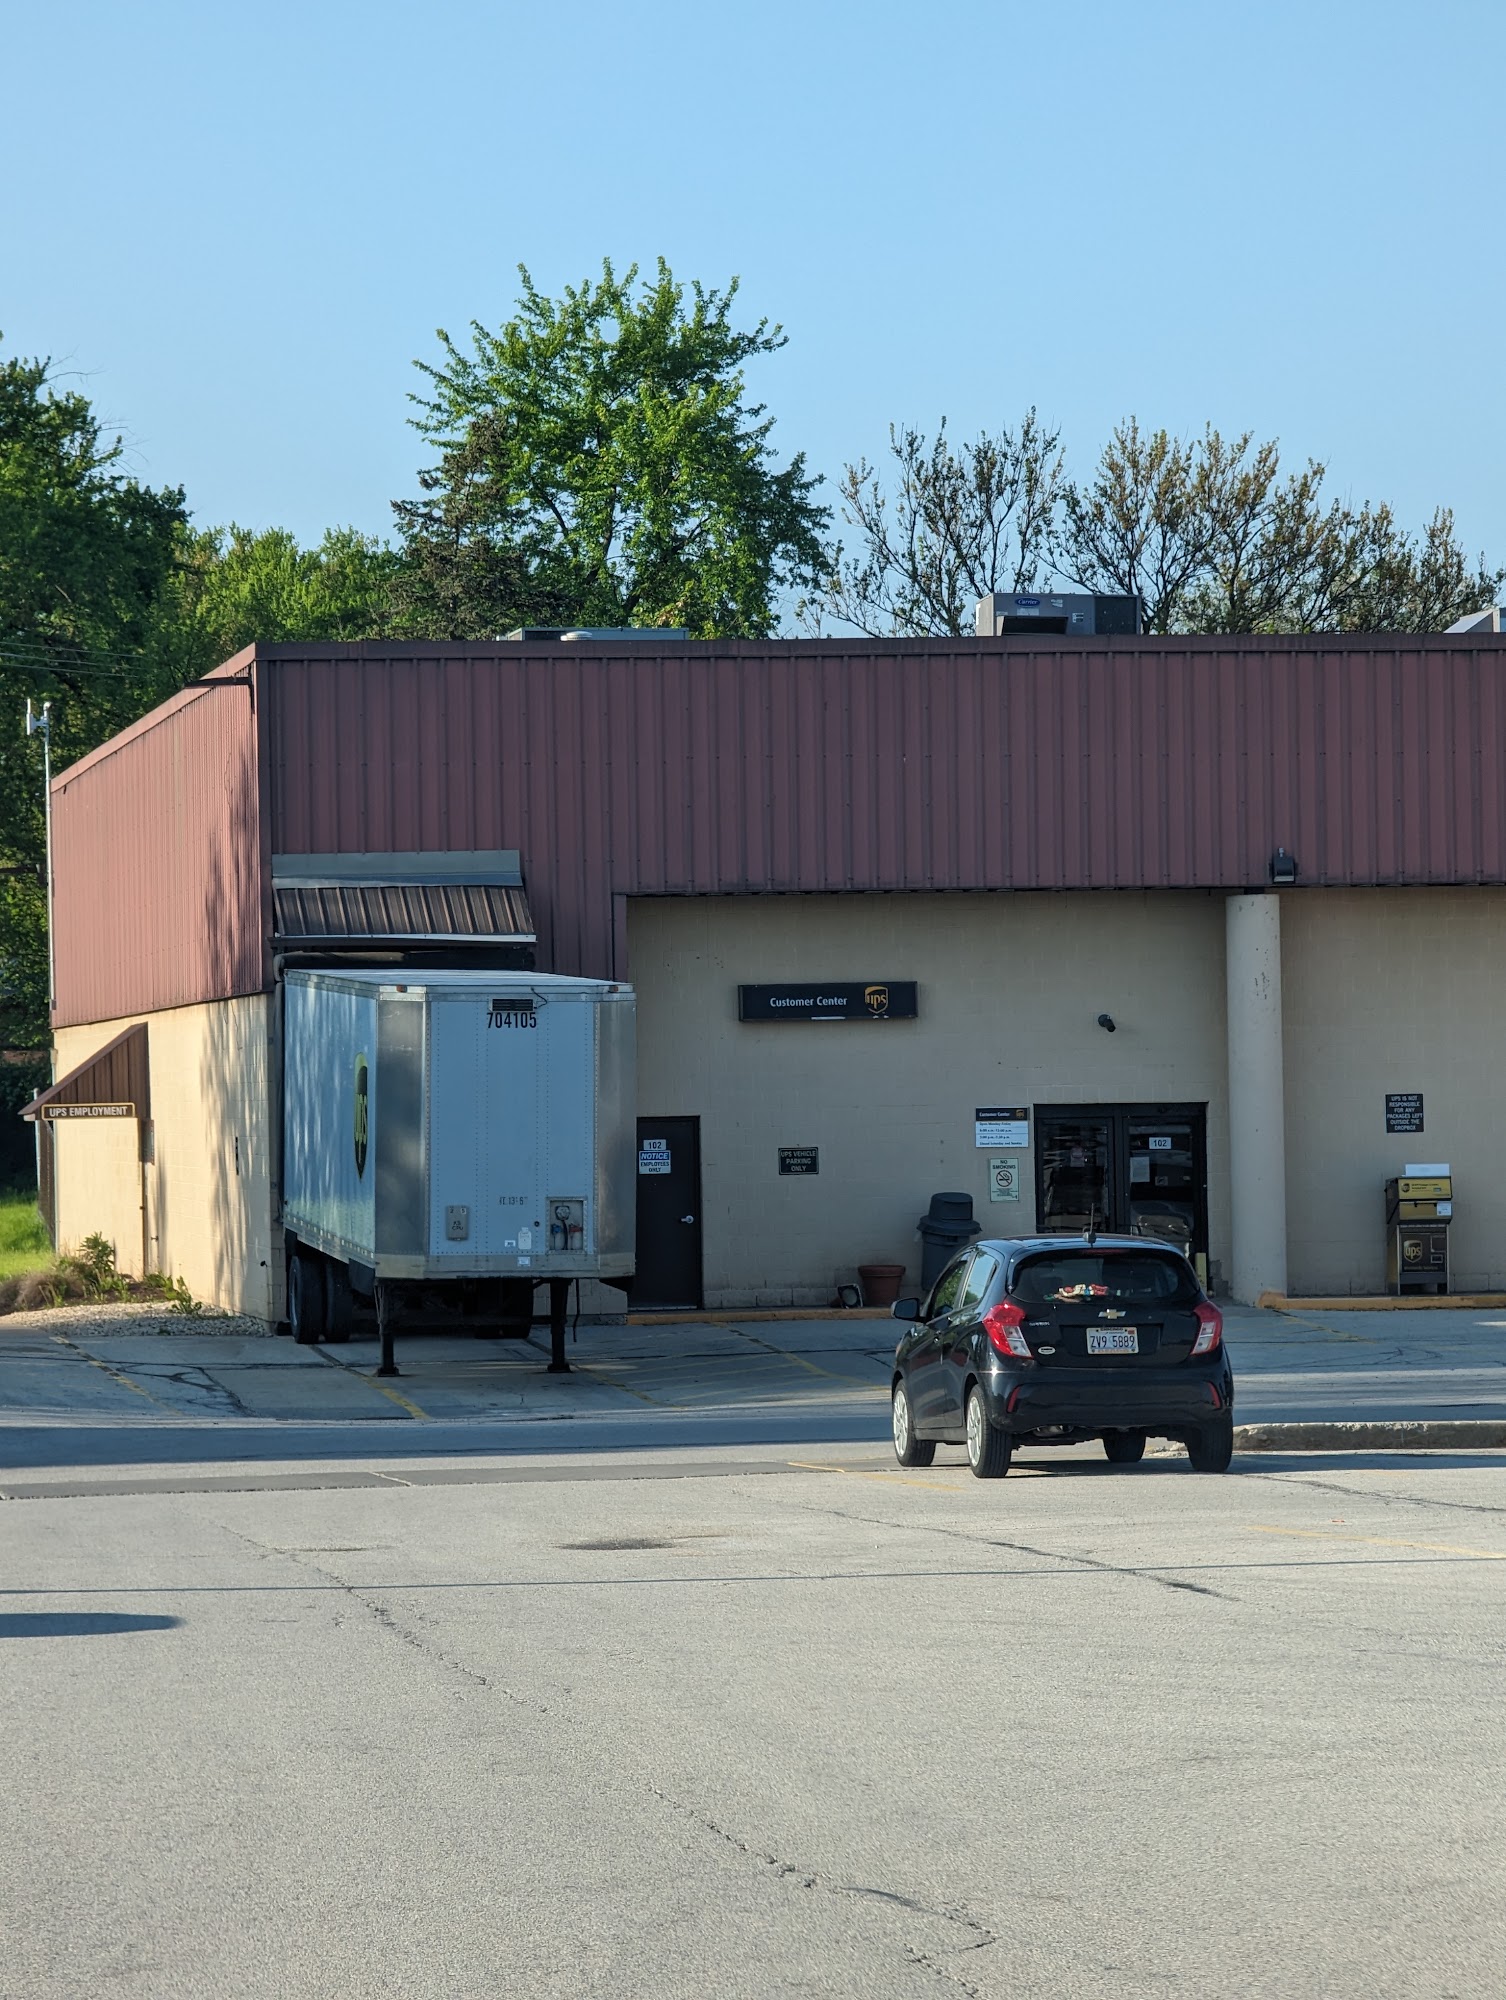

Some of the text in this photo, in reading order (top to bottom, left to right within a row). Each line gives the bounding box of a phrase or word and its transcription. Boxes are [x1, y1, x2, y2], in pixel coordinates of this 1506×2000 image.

[770, 996, 847, 1007] Customer Center
[866, 993, 887, 1009] ups
[487, 1012, 536, 1028] 704105
[49, 1106, 128, 1117] UPS EMPLOYMENT
[1090, 1336, 1134, 1348] ZV9 5889
